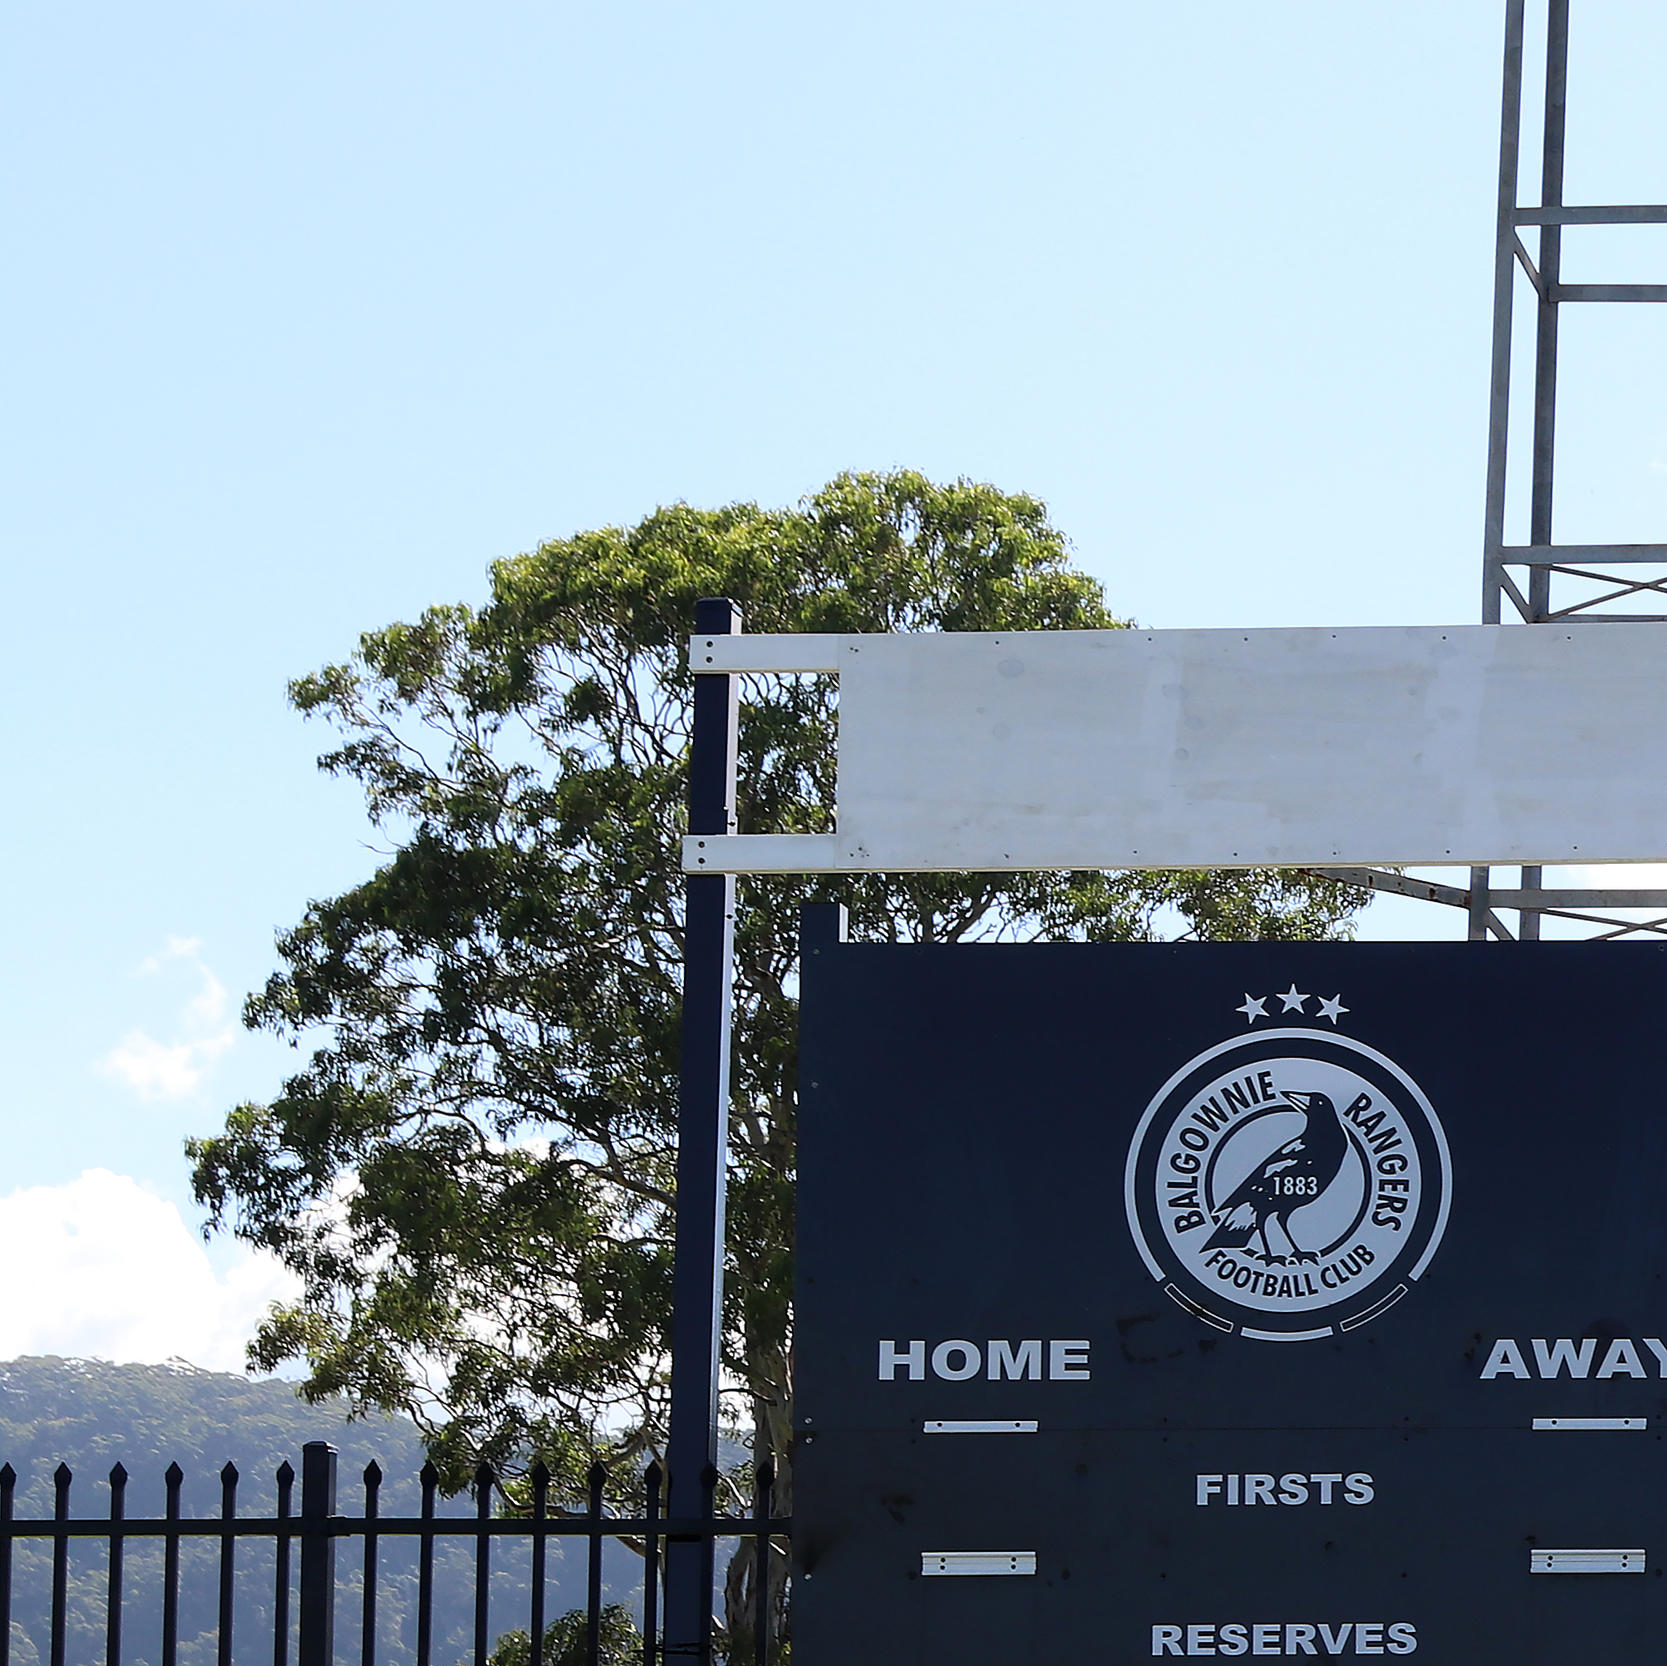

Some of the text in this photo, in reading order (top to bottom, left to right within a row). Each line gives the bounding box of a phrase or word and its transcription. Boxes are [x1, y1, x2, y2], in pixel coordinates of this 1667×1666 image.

[1166, 1070, 1277, 1233] BALGOWNIE
[1343, 1092, 1410, 1232] RANGERS
[1272, 1176, 1318, 1196] 1883
[1204, 1243, 1375, 1298] FOOTBALL CLUB
[878, 1339, 1091, 1381] HOME
[1196, 1472, 1375, 1507] FIRSTS
[1151, 1622, 1418, 1657] RESERVES
